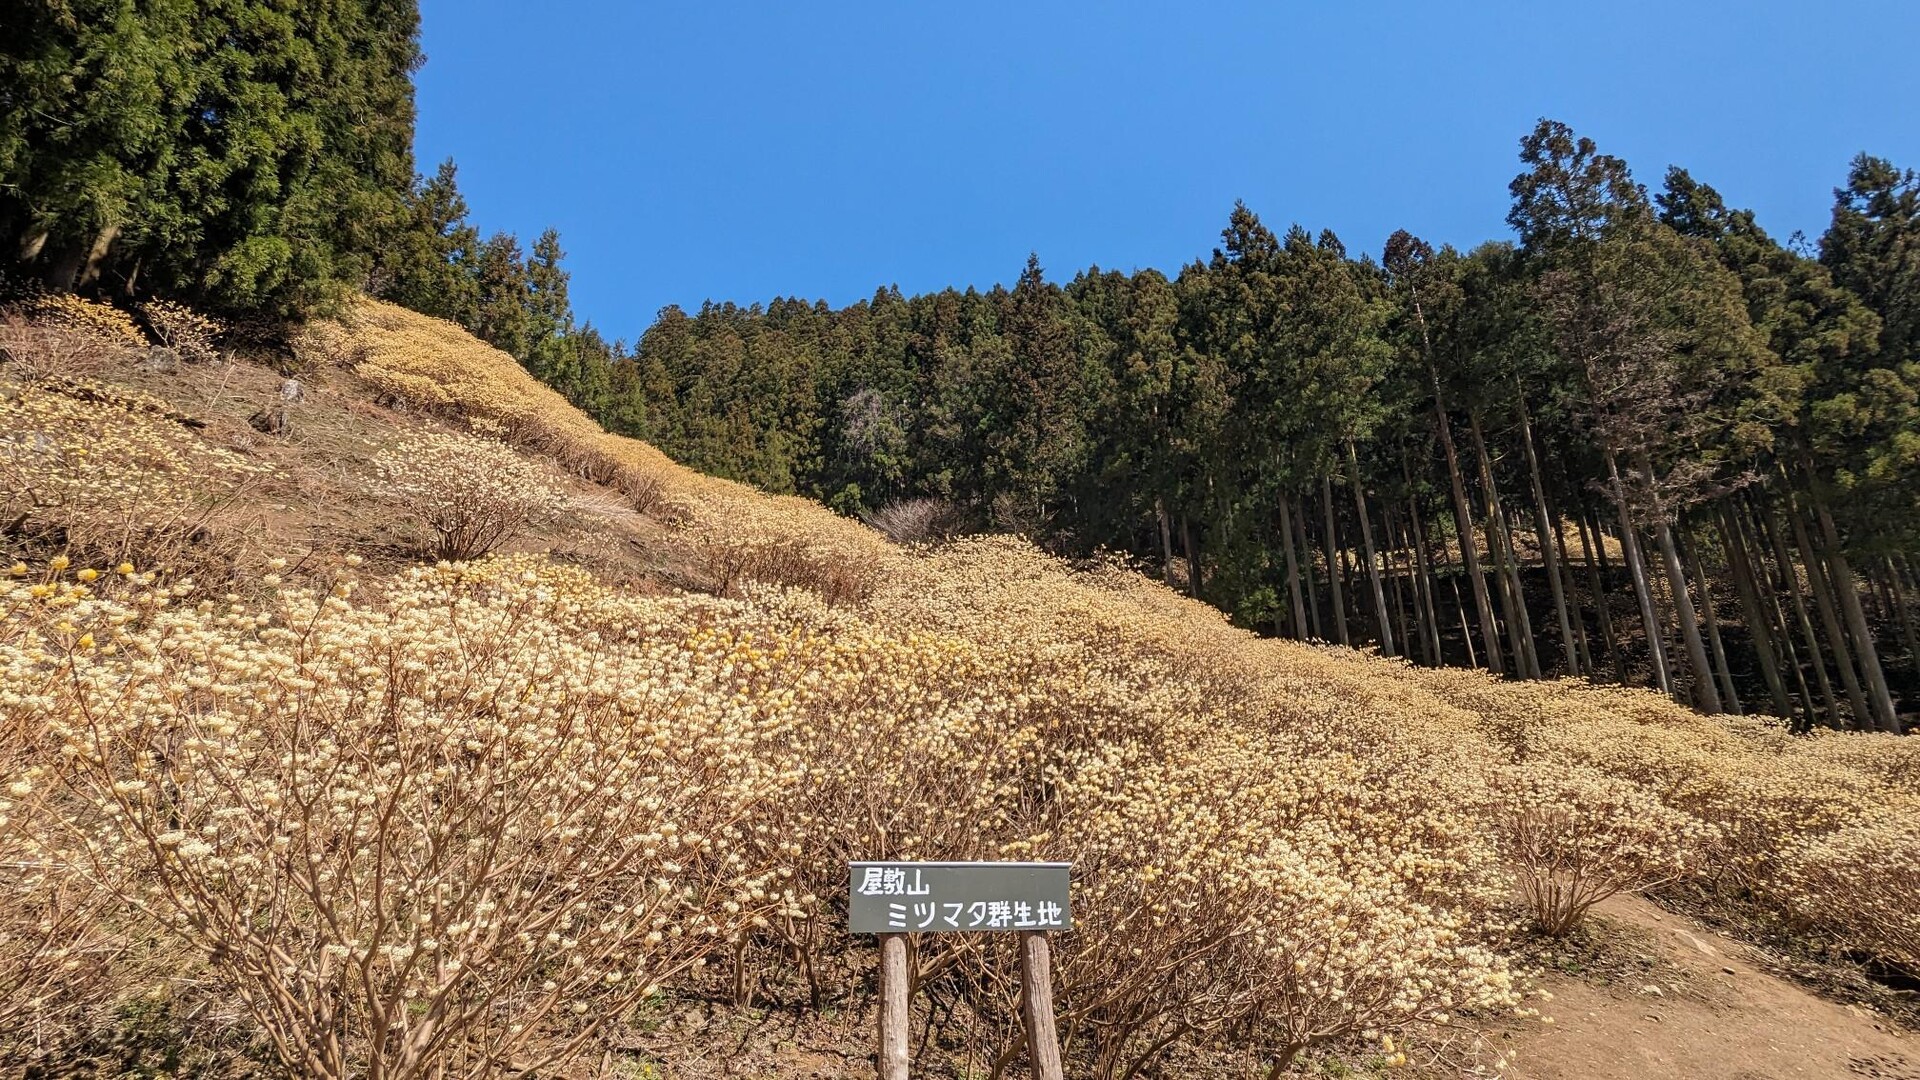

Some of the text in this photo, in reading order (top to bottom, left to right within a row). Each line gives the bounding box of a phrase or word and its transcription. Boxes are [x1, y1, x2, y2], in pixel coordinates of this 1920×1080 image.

[857, 867, 930, 895] 屋敷山
[888, 900, 1063, 928] ミツマタ群生地
